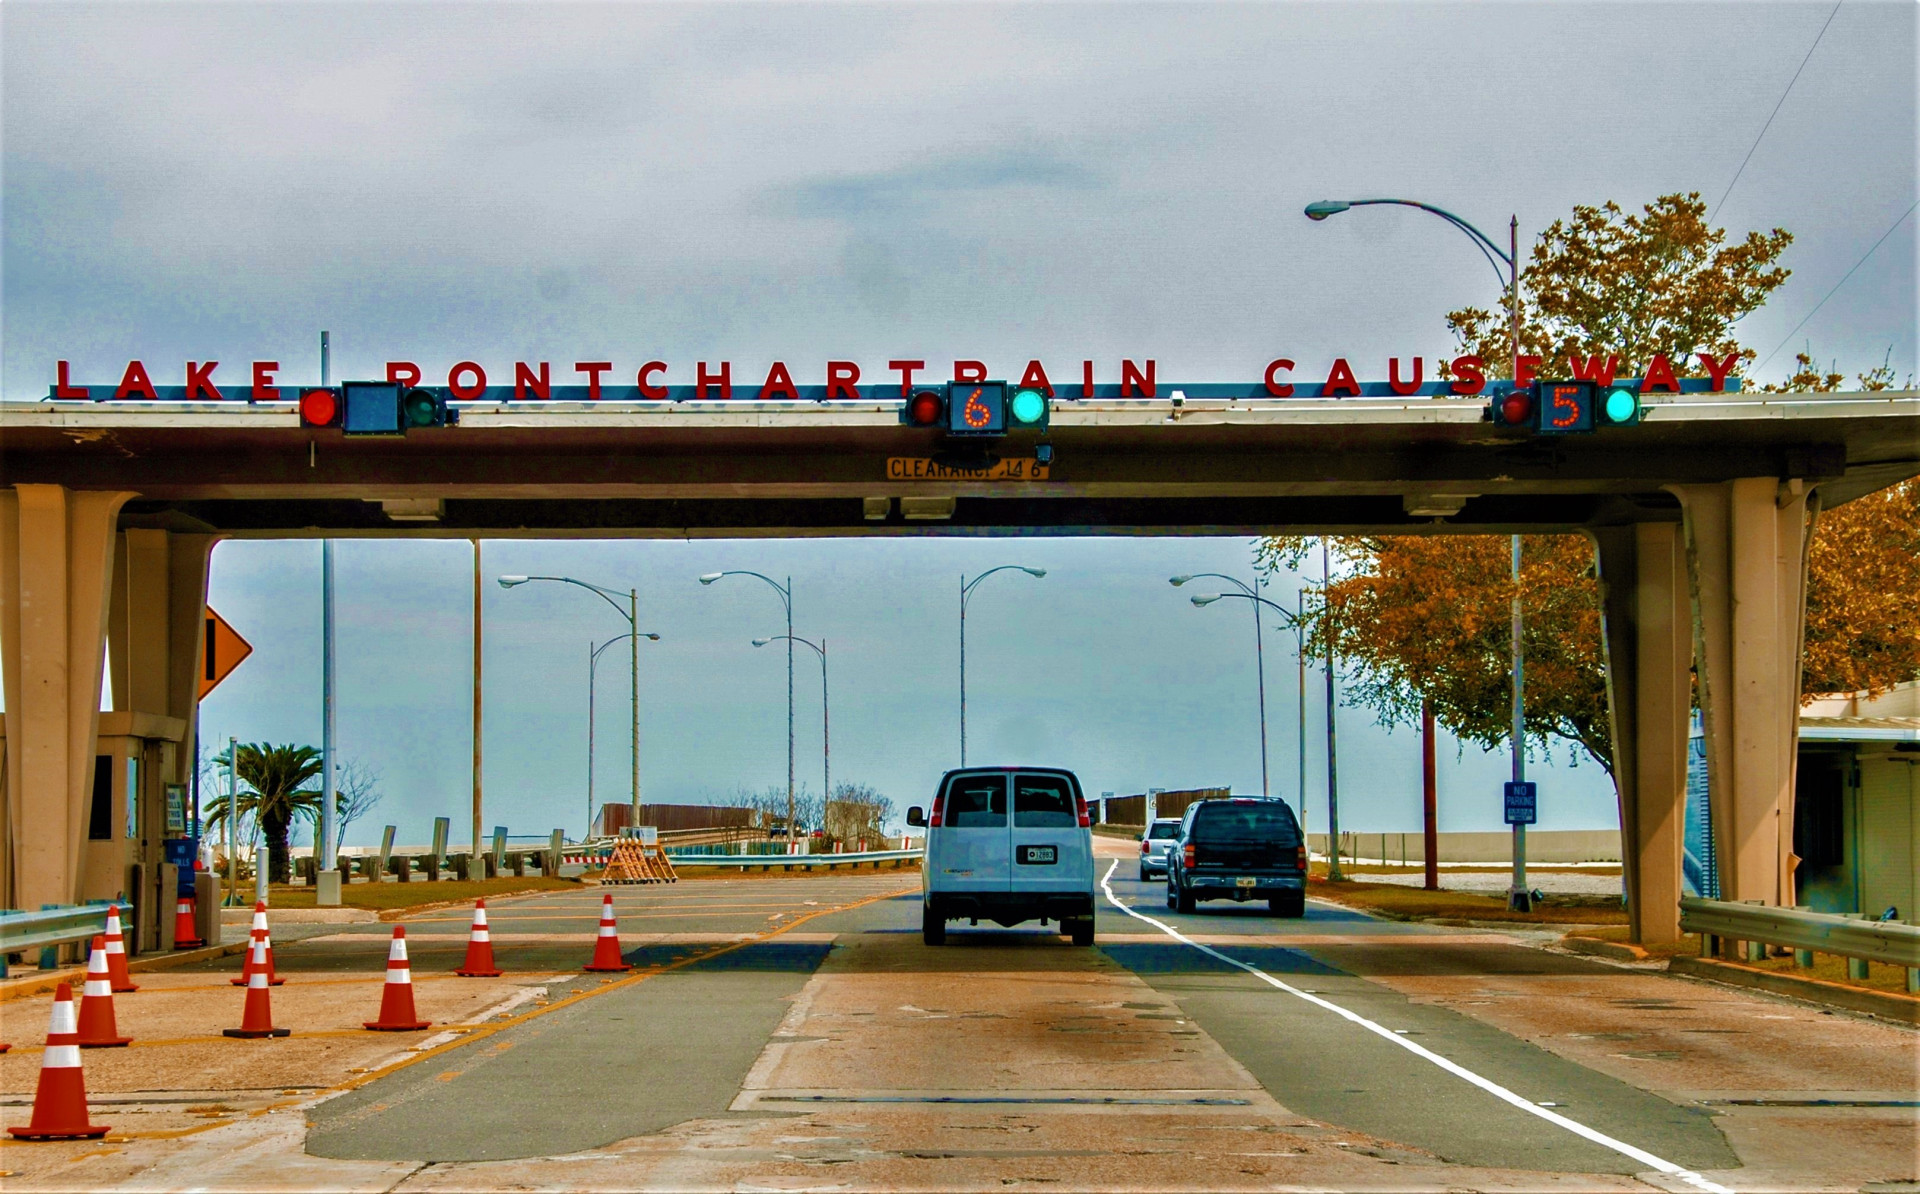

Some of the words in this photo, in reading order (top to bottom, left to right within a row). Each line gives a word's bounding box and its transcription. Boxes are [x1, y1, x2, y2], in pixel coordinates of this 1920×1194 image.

[56, 360, 281, 400] LAKE
[386, 359, 1157, 399] PONTCHARTRAIN
[1264, 353, 1741, 397] CAUSEWAY
[964, 387, 991, 428] 6
[1552, 386, 1579, 427] 5
[1506, 796, 1534, 806] PARKING
[1513, 785, 1527, 796] NO
